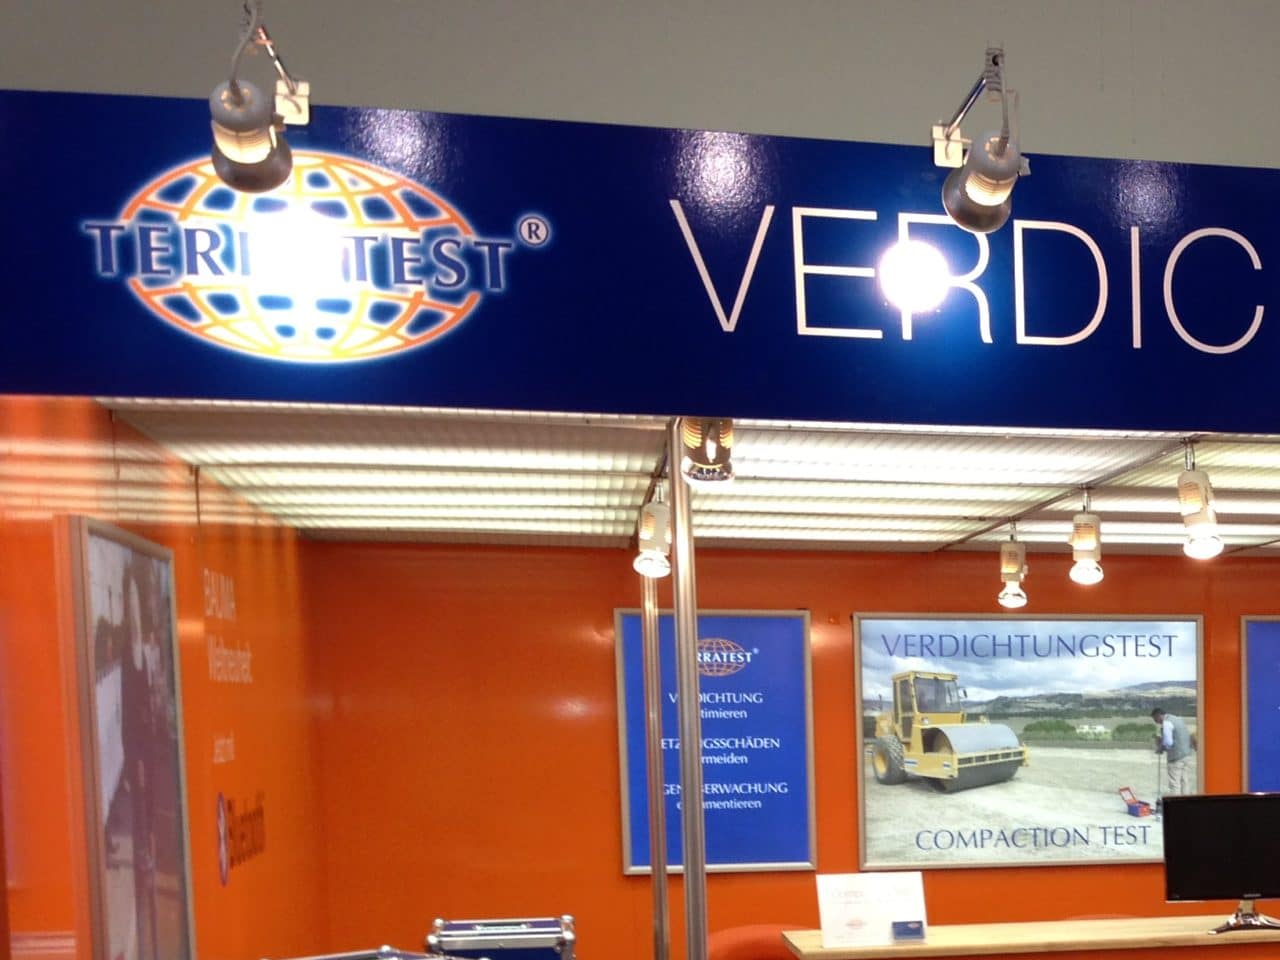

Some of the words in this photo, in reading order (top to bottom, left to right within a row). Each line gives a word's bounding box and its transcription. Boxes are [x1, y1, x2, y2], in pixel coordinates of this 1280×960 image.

[880, 633, 1179, 658] VERDICHTUNGSTEST
[700, 707, 748, 719] timieren
[701, 752, 749, 765] rmeiden
[915, 826, 1090, 851] COMPACTION
[1099, 825, 1152, 848] TEST
